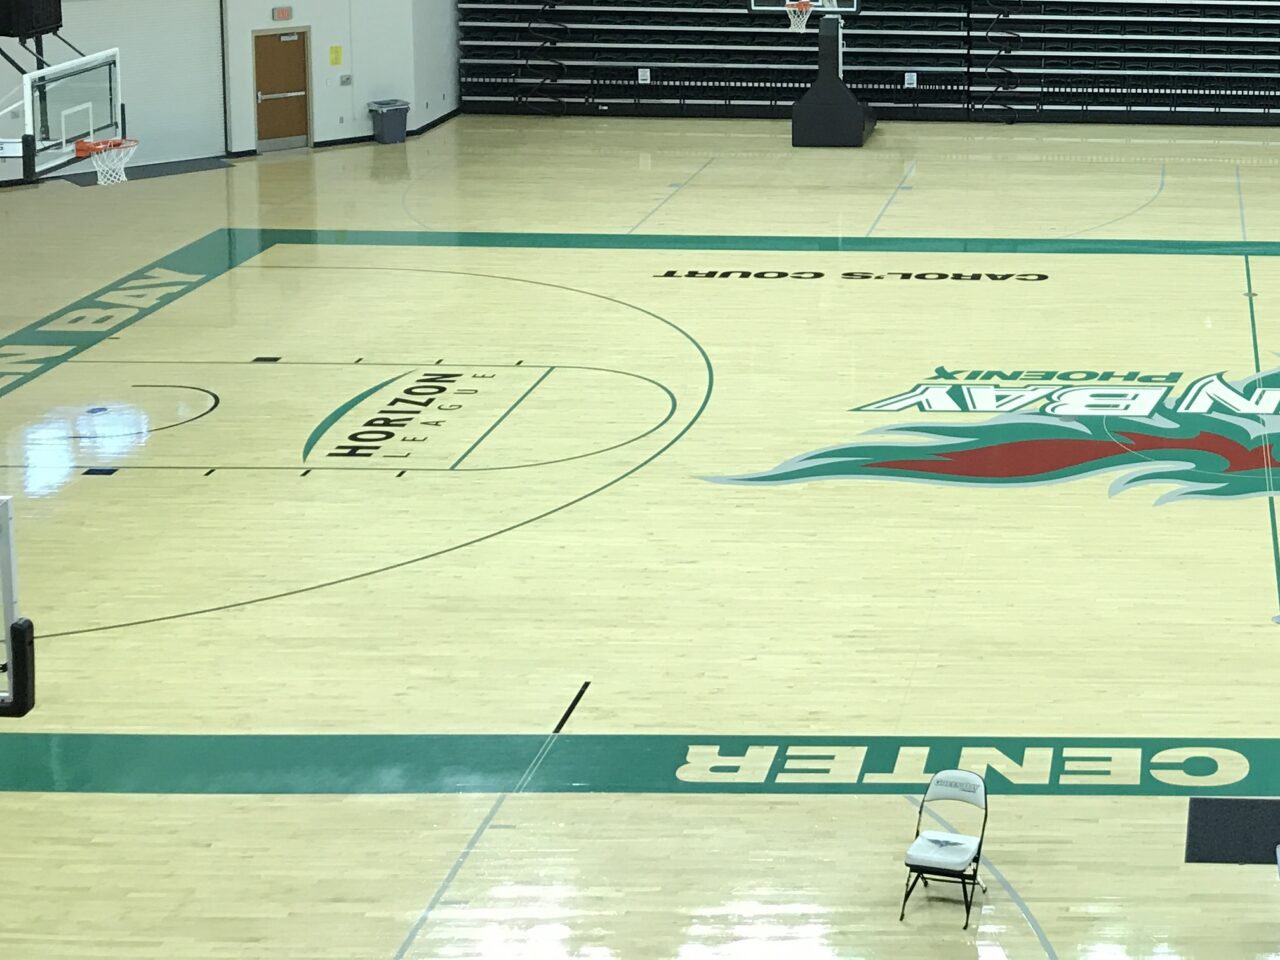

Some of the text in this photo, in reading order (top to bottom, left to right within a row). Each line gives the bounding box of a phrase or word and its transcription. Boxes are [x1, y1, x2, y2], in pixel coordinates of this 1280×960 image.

[652, 270, 1049, 282] CAROL'S COURT
[35, 267, 207, 332] BAY
[923, 365, 1185, 384] PHOENIX
[326, 373, 464, 457] HORIZON
[382, 373, 496, 458] LEAGUE
[847, 383, 1175, 418] BAY
[676, 745, 1250, 787] CENTER
